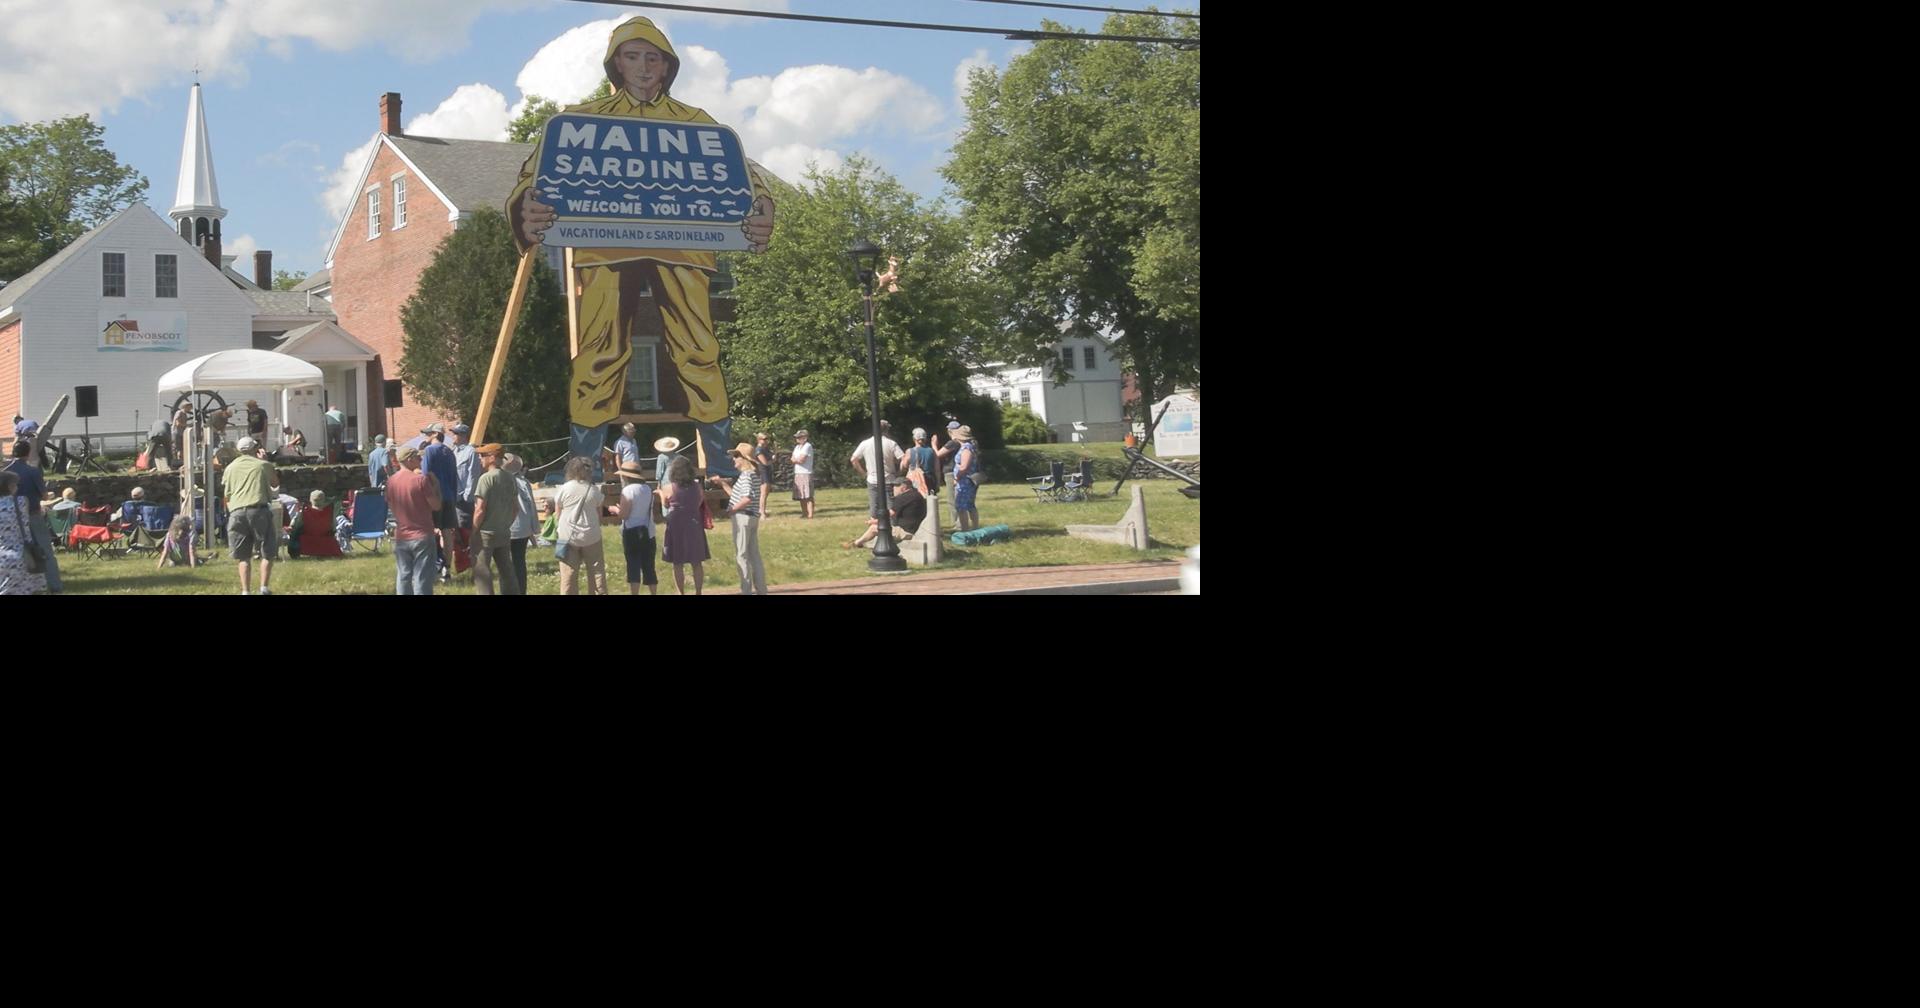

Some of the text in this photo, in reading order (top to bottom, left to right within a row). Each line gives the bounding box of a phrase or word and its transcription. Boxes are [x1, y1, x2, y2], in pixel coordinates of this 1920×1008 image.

[558, 122, 725, 157] MAINE
[555, 154, 728, 182] SARDINES
[567, 199, 725, 218] WELCOME YOU TO...
[560, 227, 644, 240] VACATIONLAND
[654, 230, 725, 242] SARDINELAND
[125, 332, 181, 340] PENOBSCOT
